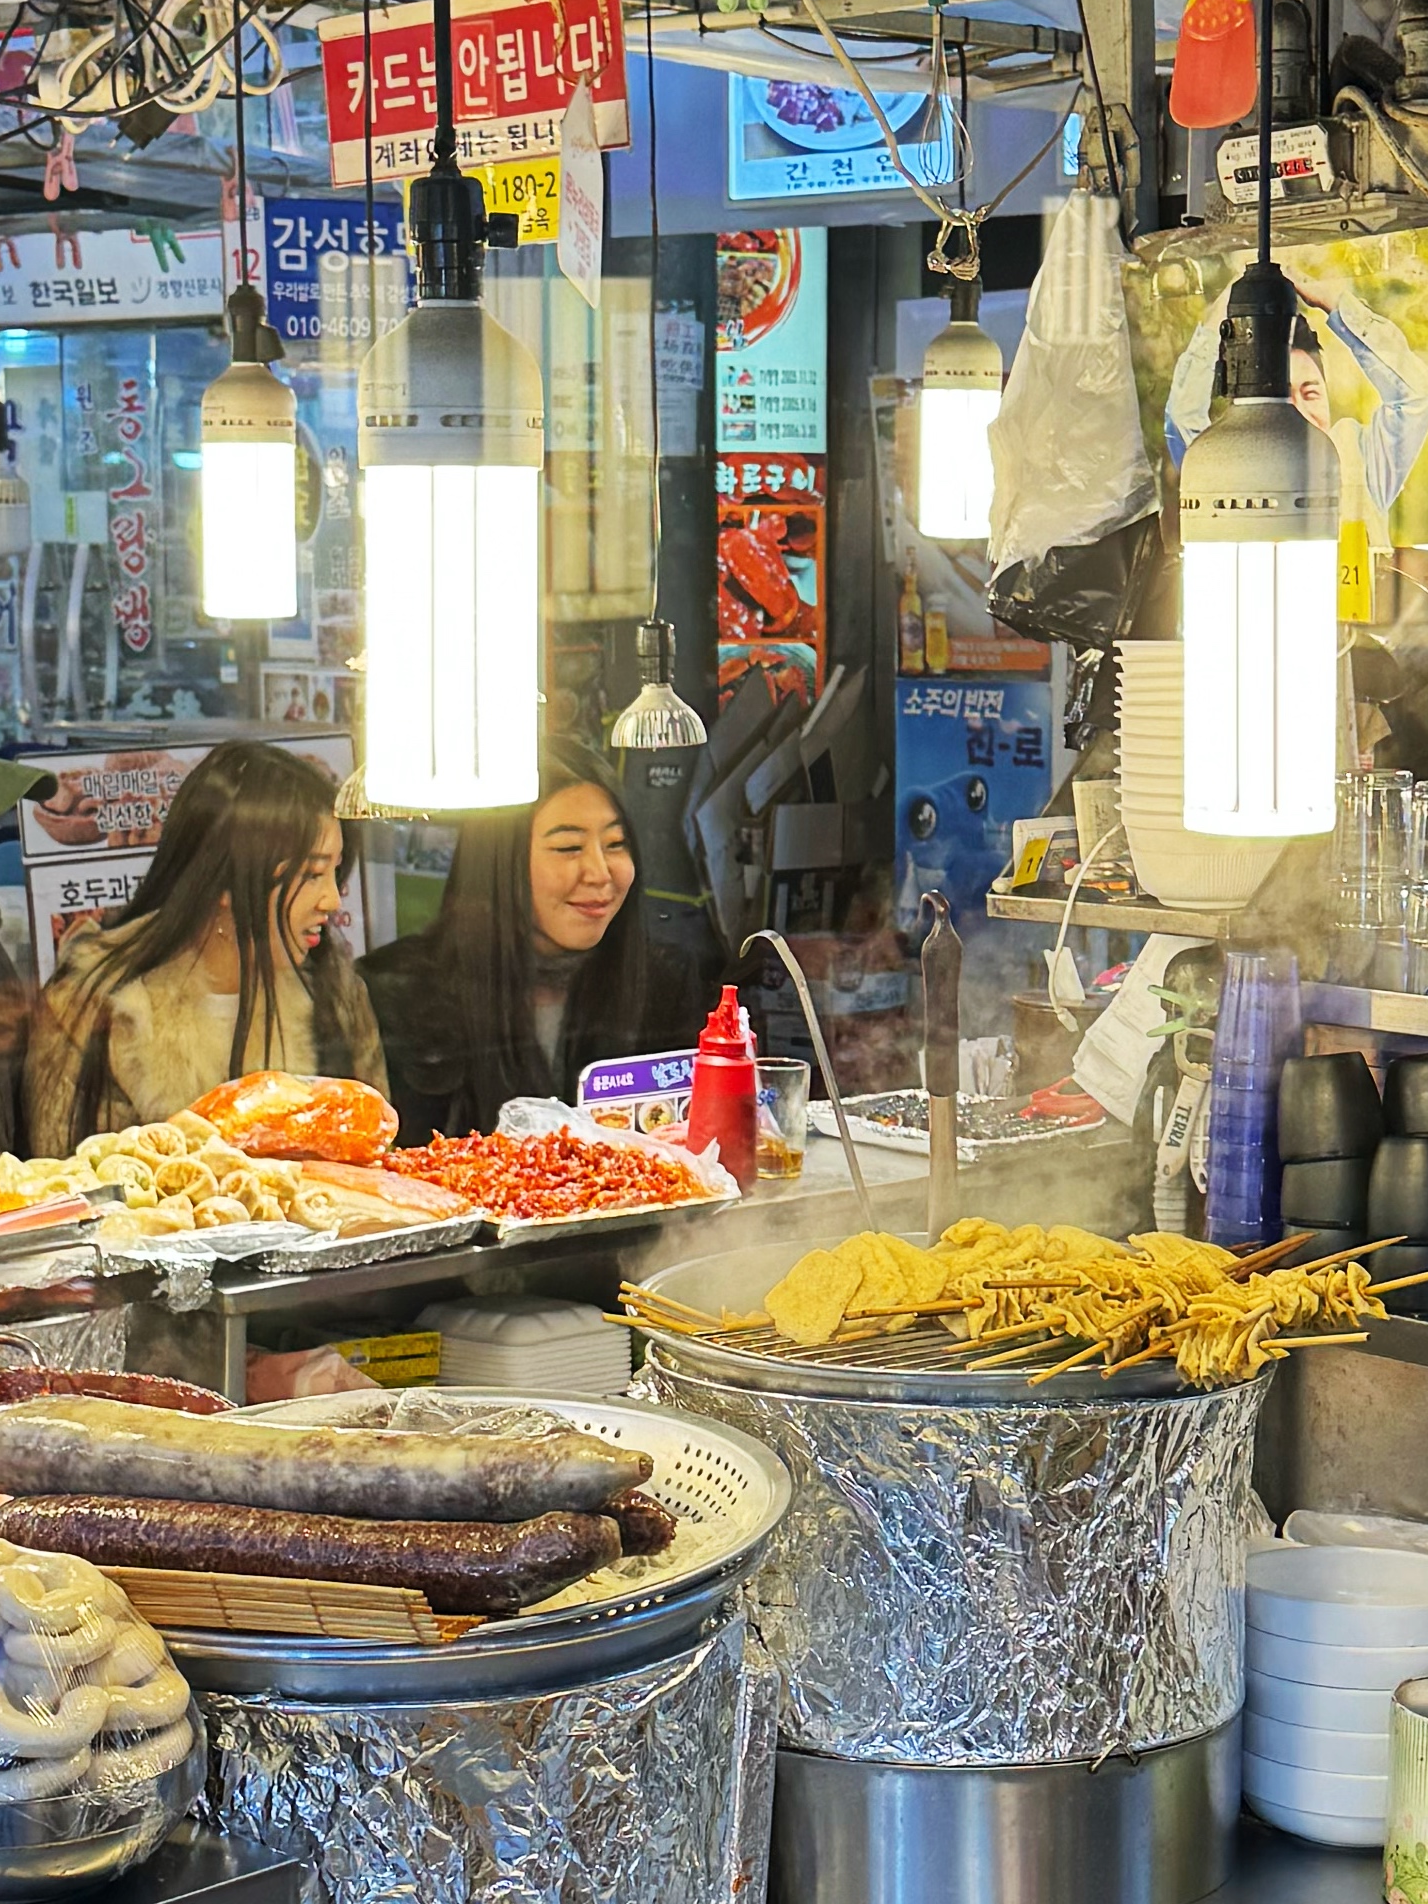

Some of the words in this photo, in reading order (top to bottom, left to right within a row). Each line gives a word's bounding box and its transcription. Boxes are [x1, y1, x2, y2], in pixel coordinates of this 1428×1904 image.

[29, 276, 121, 308] 한국일보
[903, 687, 963, 718] 소주의
[963, 690, 1005, 721] 반전
[82, 770, 158, 800] 매일매일
[97, 801, 153, 834] 신선한
